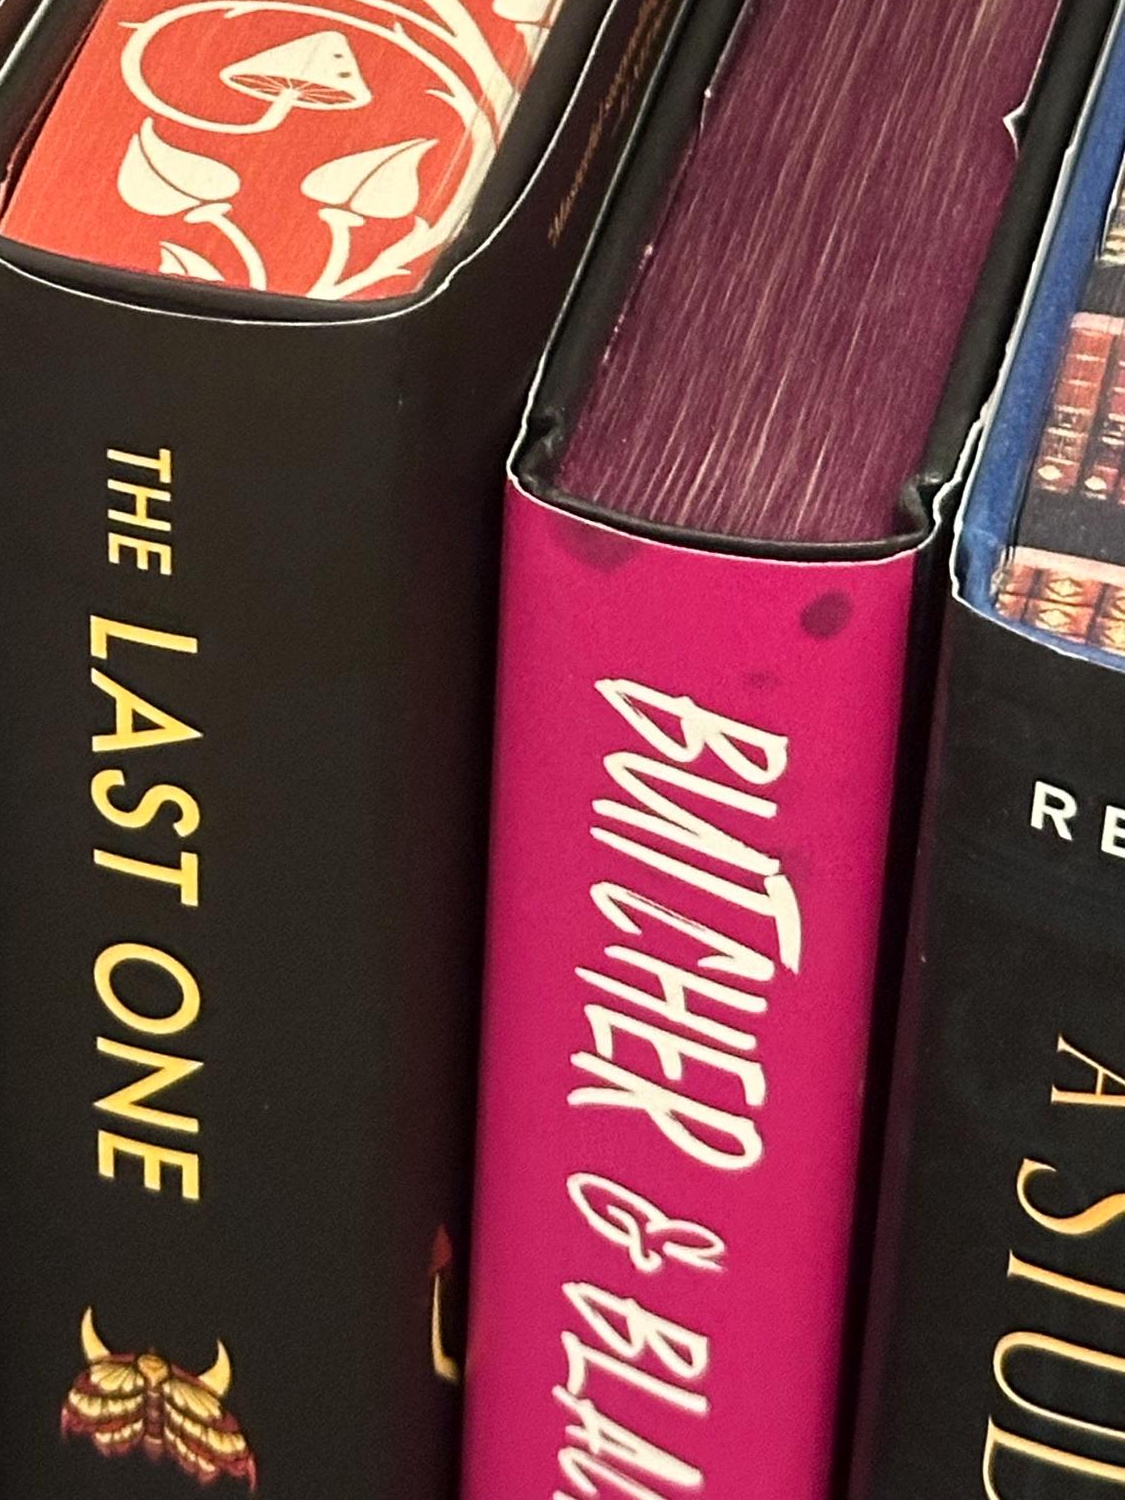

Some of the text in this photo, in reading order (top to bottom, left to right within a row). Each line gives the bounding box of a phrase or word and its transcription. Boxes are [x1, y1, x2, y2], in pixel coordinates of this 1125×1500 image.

[90, 448, 204, 1200] THE LAST ONE
[566, 678, 803, 1170] BUTCHER
[565, 1170, 726, 1274] &
